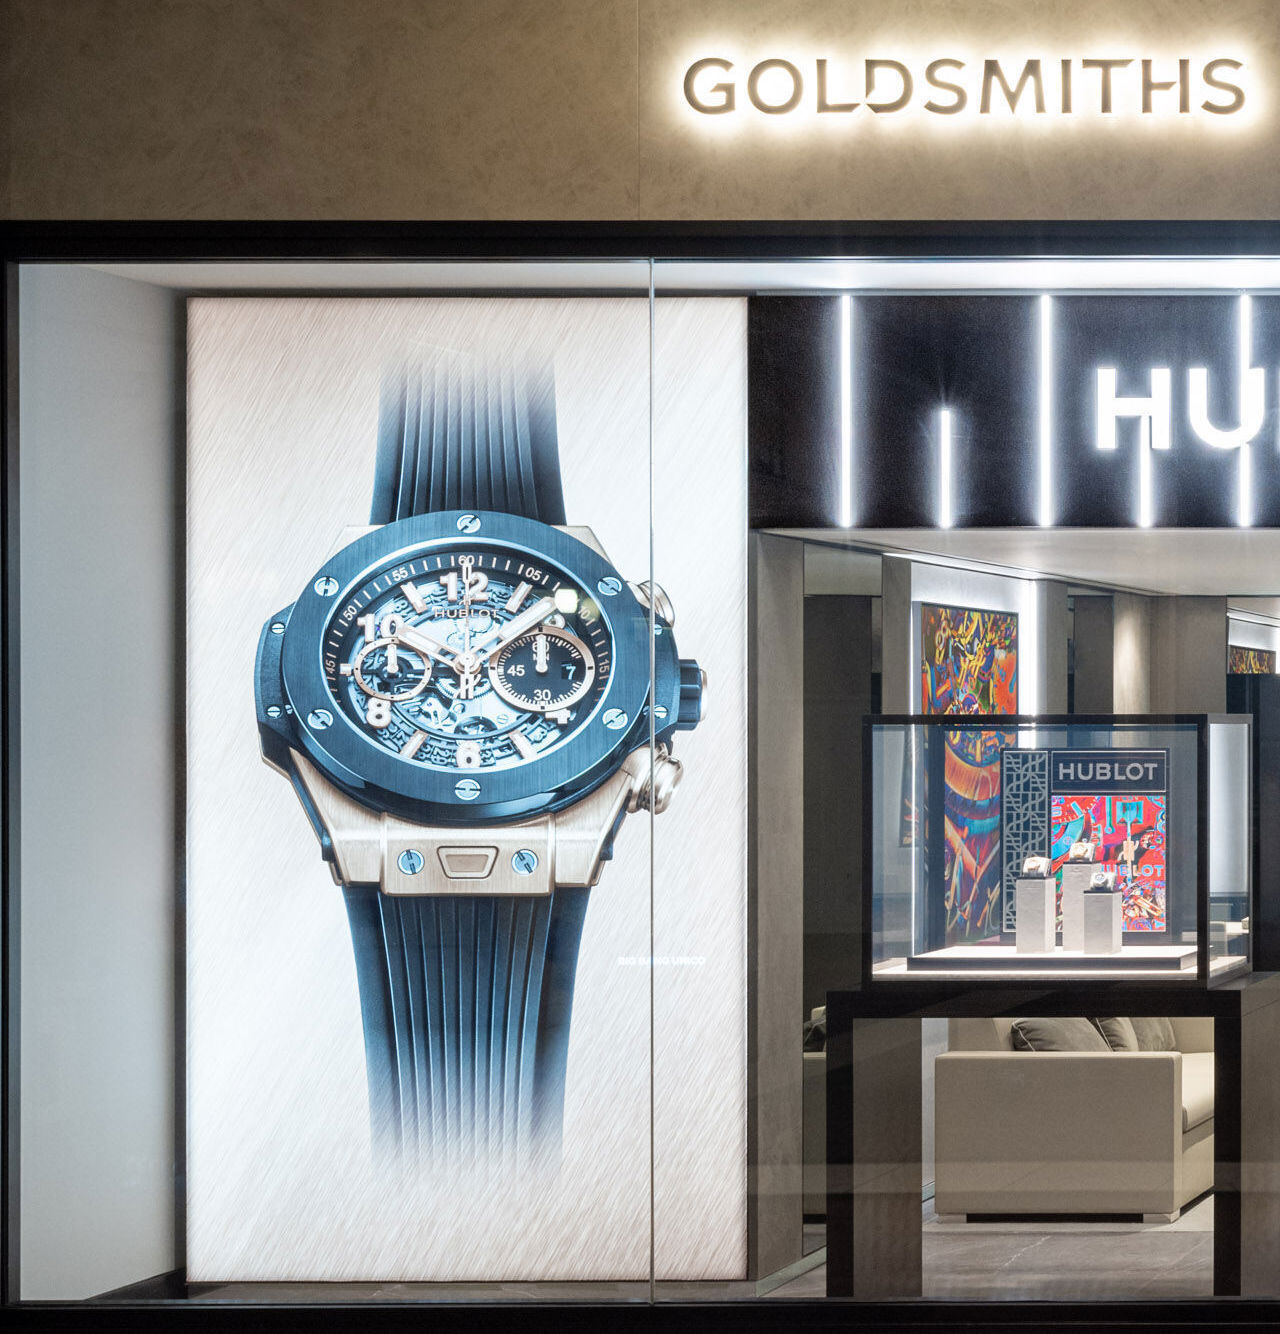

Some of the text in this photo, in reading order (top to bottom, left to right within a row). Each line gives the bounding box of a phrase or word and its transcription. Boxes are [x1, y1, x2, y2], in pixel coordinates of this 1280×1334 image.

[683, 57, 1246, 115] GOLDSMITHS
[392, 567, 409, 582] 55
[525, 567, 541, 581] 05
[440, 571, 489, 602] 12
[343, 604, 358, 621] 50
[434, 608, 499, 618] HUBLOT
[357, 613, 403, 642] 10
[325, 659, 336, 675] 45
[507, 664, 526, 677] 45
[599, 659, 610, 673] 15
[533, 689, 552, 701] 30
[366, 698, 392, 729] 8
[456, 740, 482, 769] 6
[1058, 762, 1158, 780] HUBLOT
[1101, 864, 1164, 877] UBLOT
